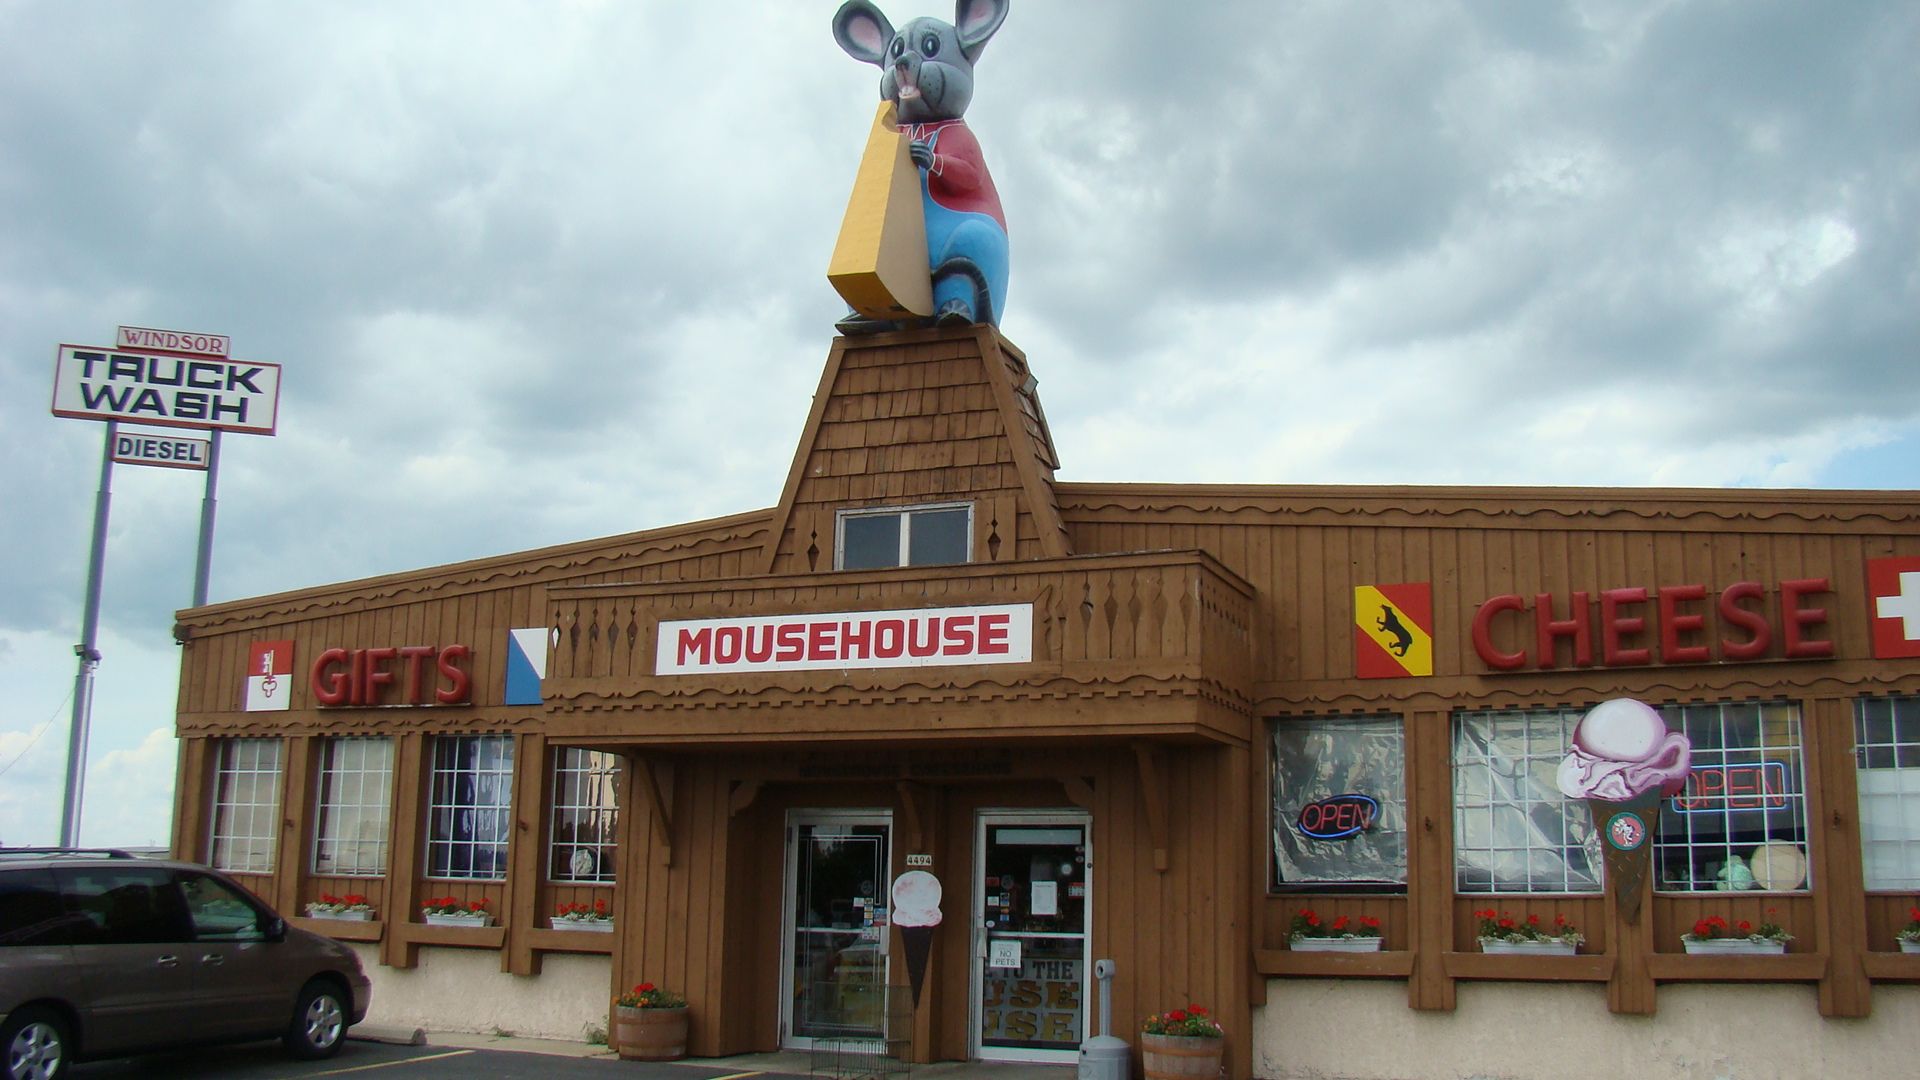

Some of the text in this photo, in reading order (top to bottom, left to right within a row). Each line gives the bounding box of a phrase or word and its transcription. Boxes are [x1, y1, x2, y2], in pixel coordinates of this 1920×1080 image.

[124, 329, 223, 352] WINDSOR
[73, 351, 264, 394] TRUCK
[80, 382, 249, 423] WASH
[118, 437, 202, 461] DIESEL
[1471, 578, 1834, 670] CHEESE
[676, 613, 1010, 666] MOUSEHOUSE
[311, 644, 474, 706] GIFTS
[1677, 767, 1786, 809] OPEN
[1302, 803, 1372, 830] OPEN
[907, 855, 931, 865] 4494
[995, 958, 1016, 966] PETS
[999, 950, 1012, 958] NO
[1032, 961, 1074, 980] THE
